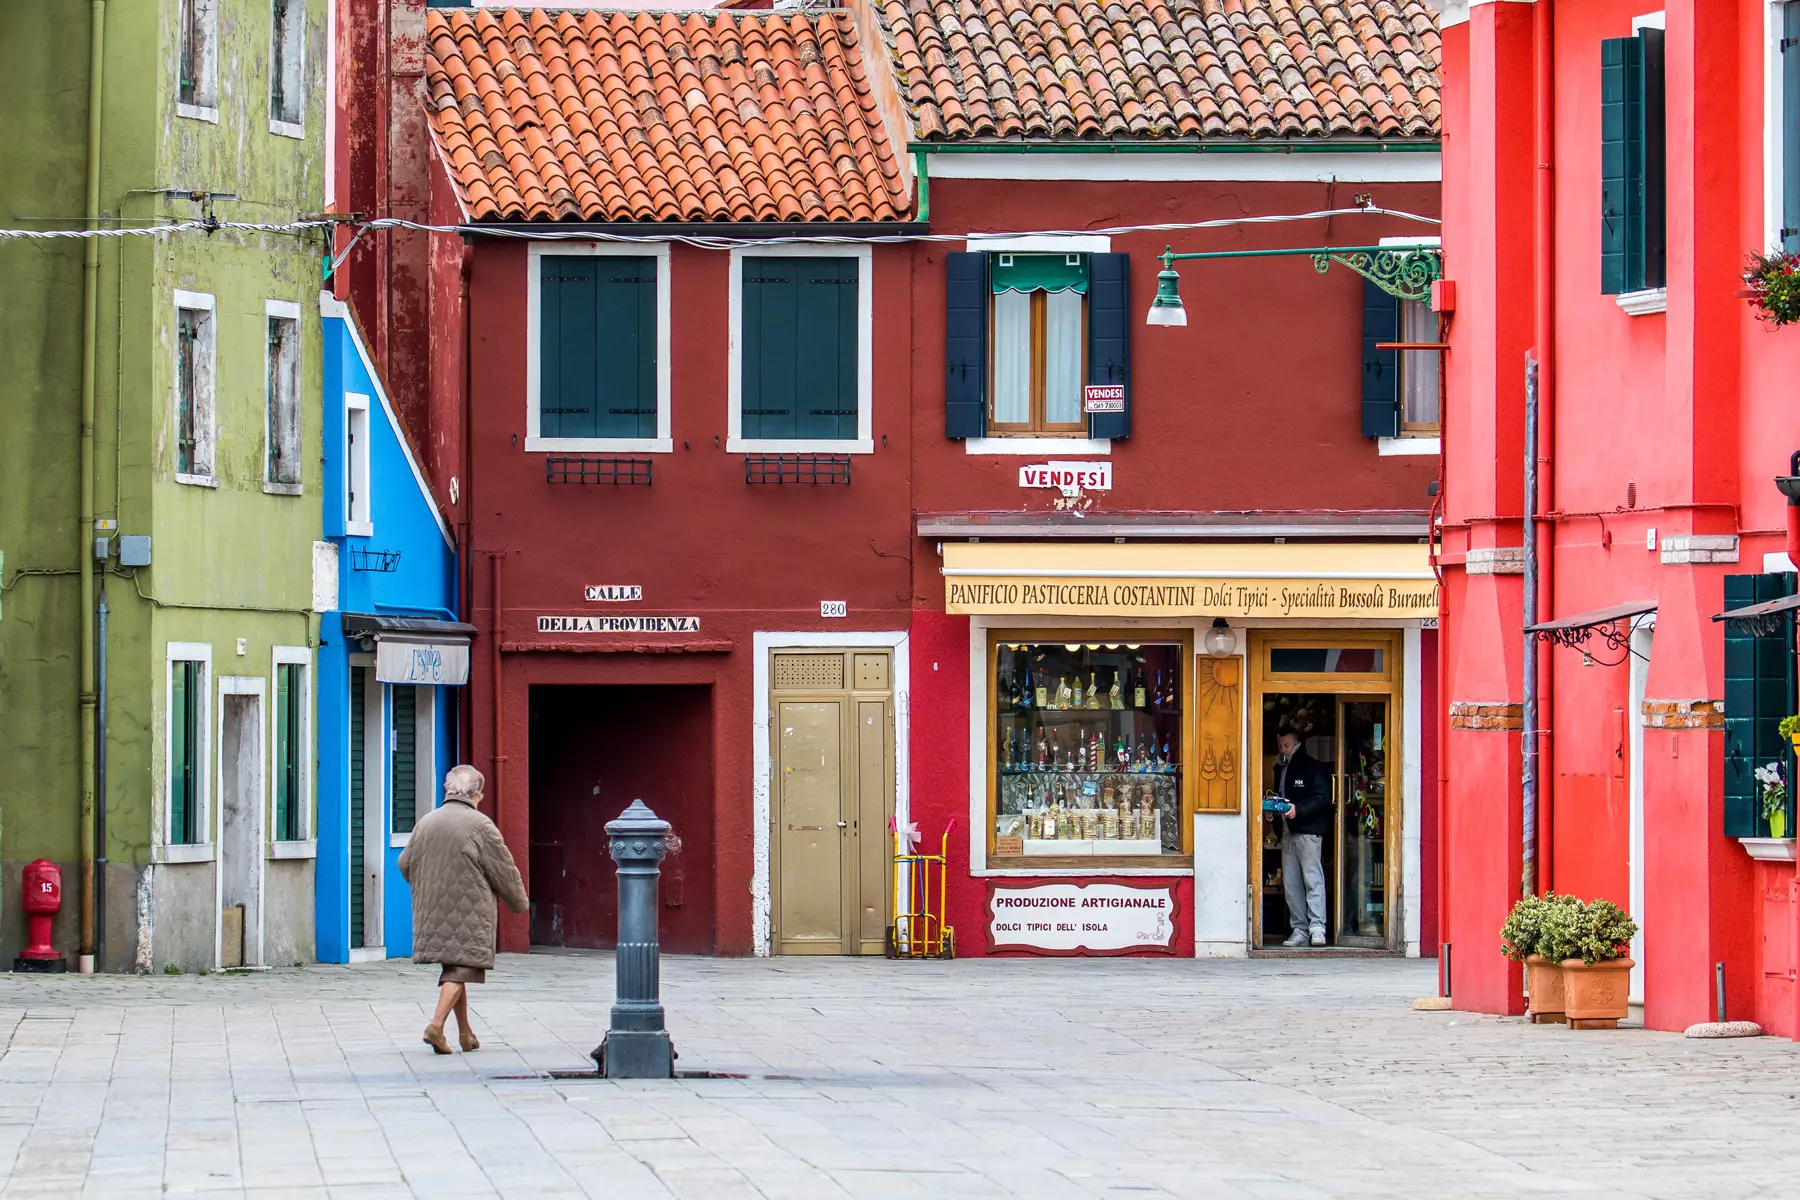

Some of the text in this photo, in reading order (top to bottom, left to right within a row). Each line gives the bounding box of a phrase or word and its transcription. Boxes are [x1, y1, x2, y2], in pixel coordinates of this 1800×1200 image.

[1087, 389, 1122, 398] VENDESI
[1024, 470, 1105, 486] VENDESI
[585, 586, 641, 600] CALLE
[950, 584, 1018, 605] PANIFICIO
[1021, 584, 1110, 606] PASTICCERIA
[1113, 585, 1196, 606] COSTANTINI
[1203, 583, 1232, 607] Dolci
[1236, 586, 1268, 616] Tipici
[1280, 583, 1335, 616] Specialità
[1339, 583, 1384, 609] Bussolà
[822, 603, 845, 615] 280
[539, 617, 699, 631] DELLA PROVIDENZA
[41, 882, 52, 893] 15
[996, 898, 1166, 908] PRODUZIONE ARTIGIANALE
[996, 923, 1108, 931] DOLCI TIPICI DELL' ISOLA
